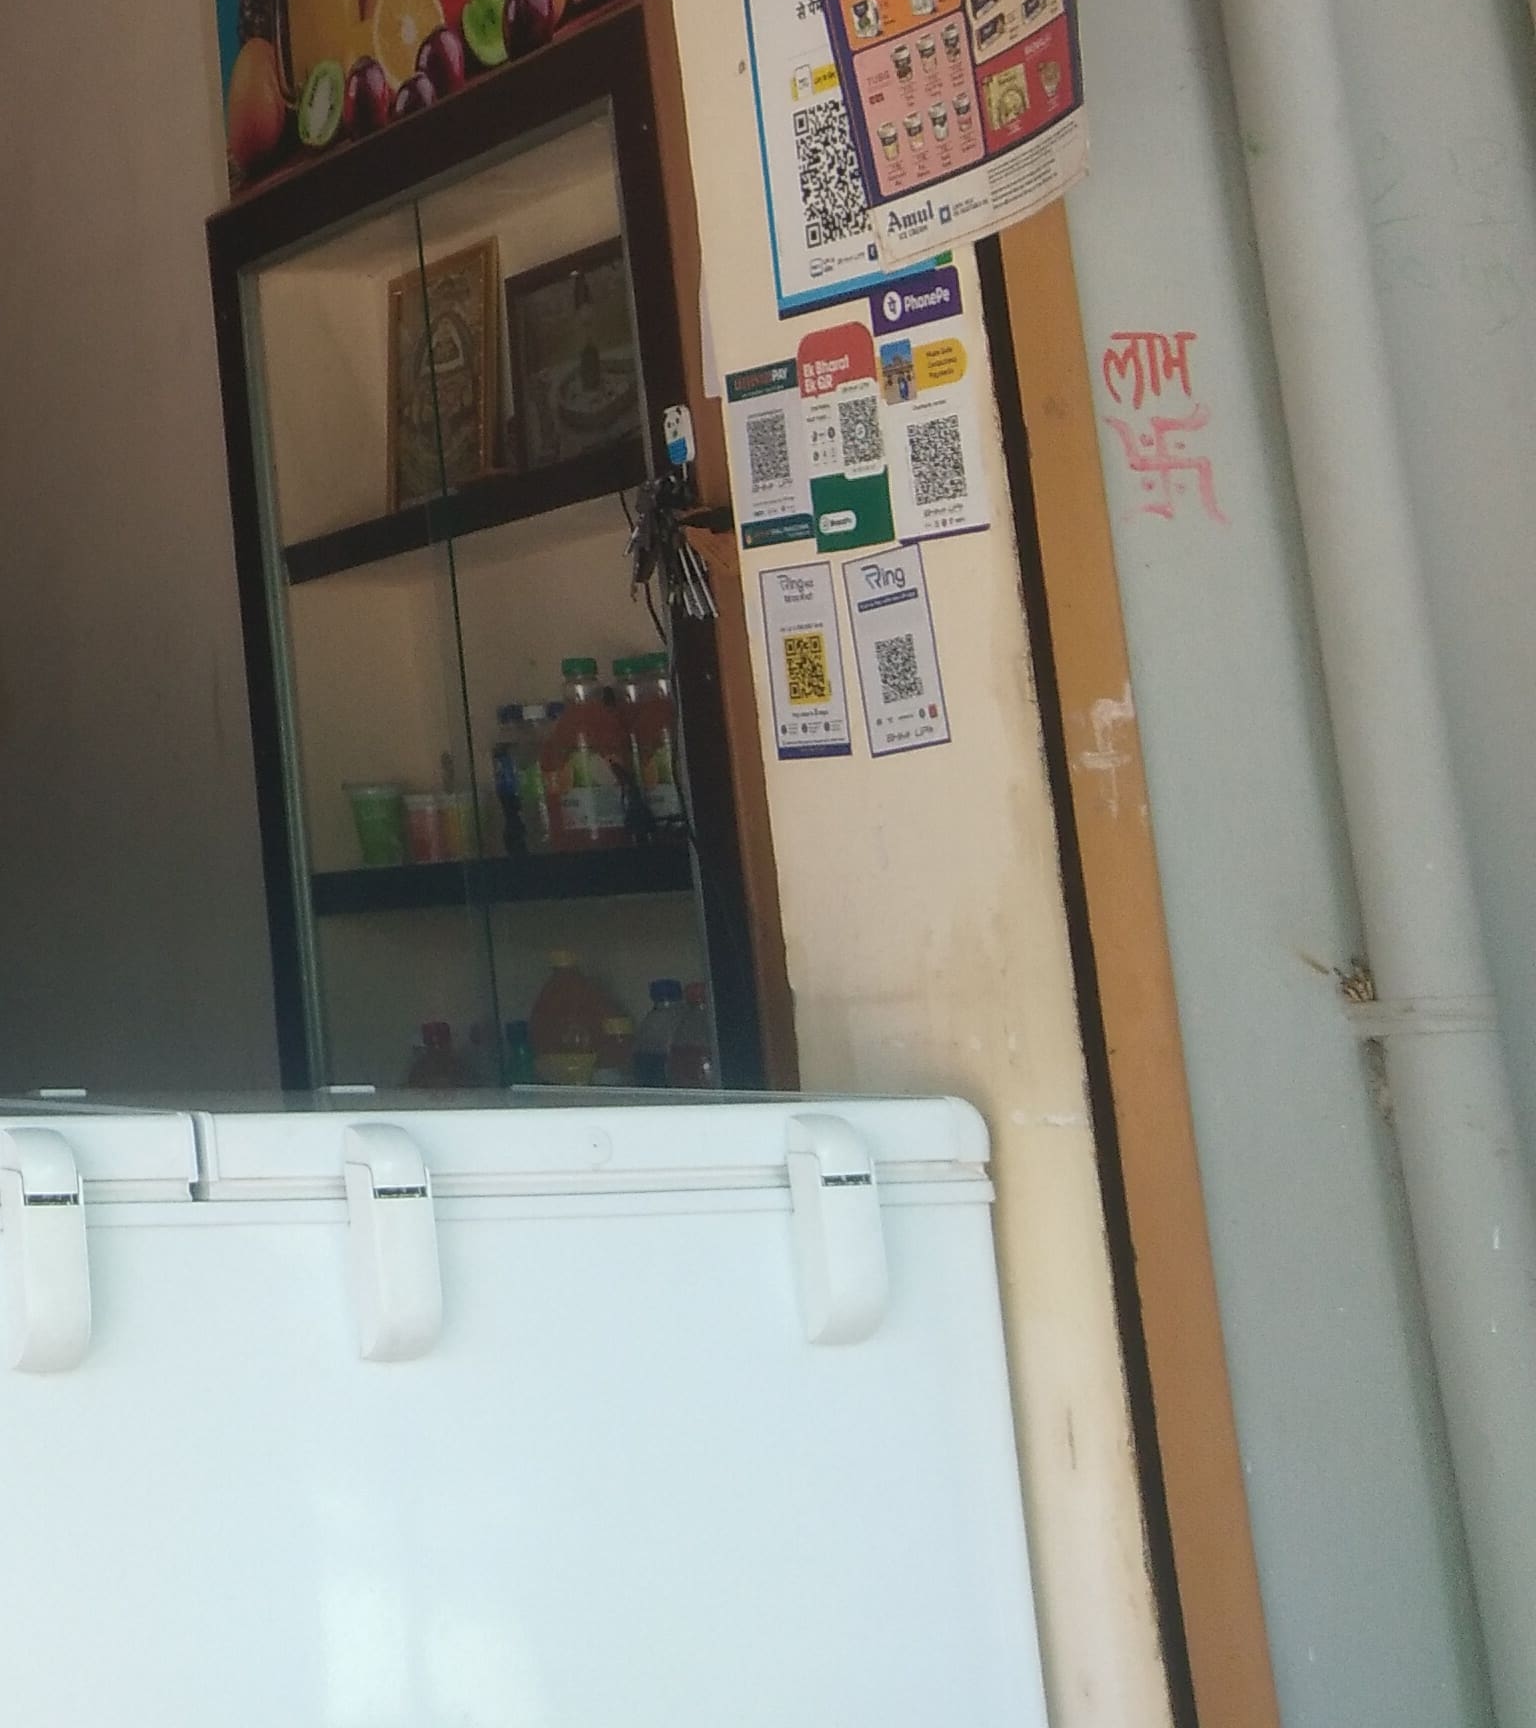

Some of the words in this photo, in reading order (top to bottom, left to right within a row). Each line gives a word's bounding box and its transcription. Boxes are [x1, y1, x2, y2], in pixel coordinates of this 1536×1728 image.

[887, 200, 934, 235] Amul
[904, 286, 950, 312] PhonePe
[1102, 331, 1197, 409] लाभ
[861, 563, 906, 589] Ring
